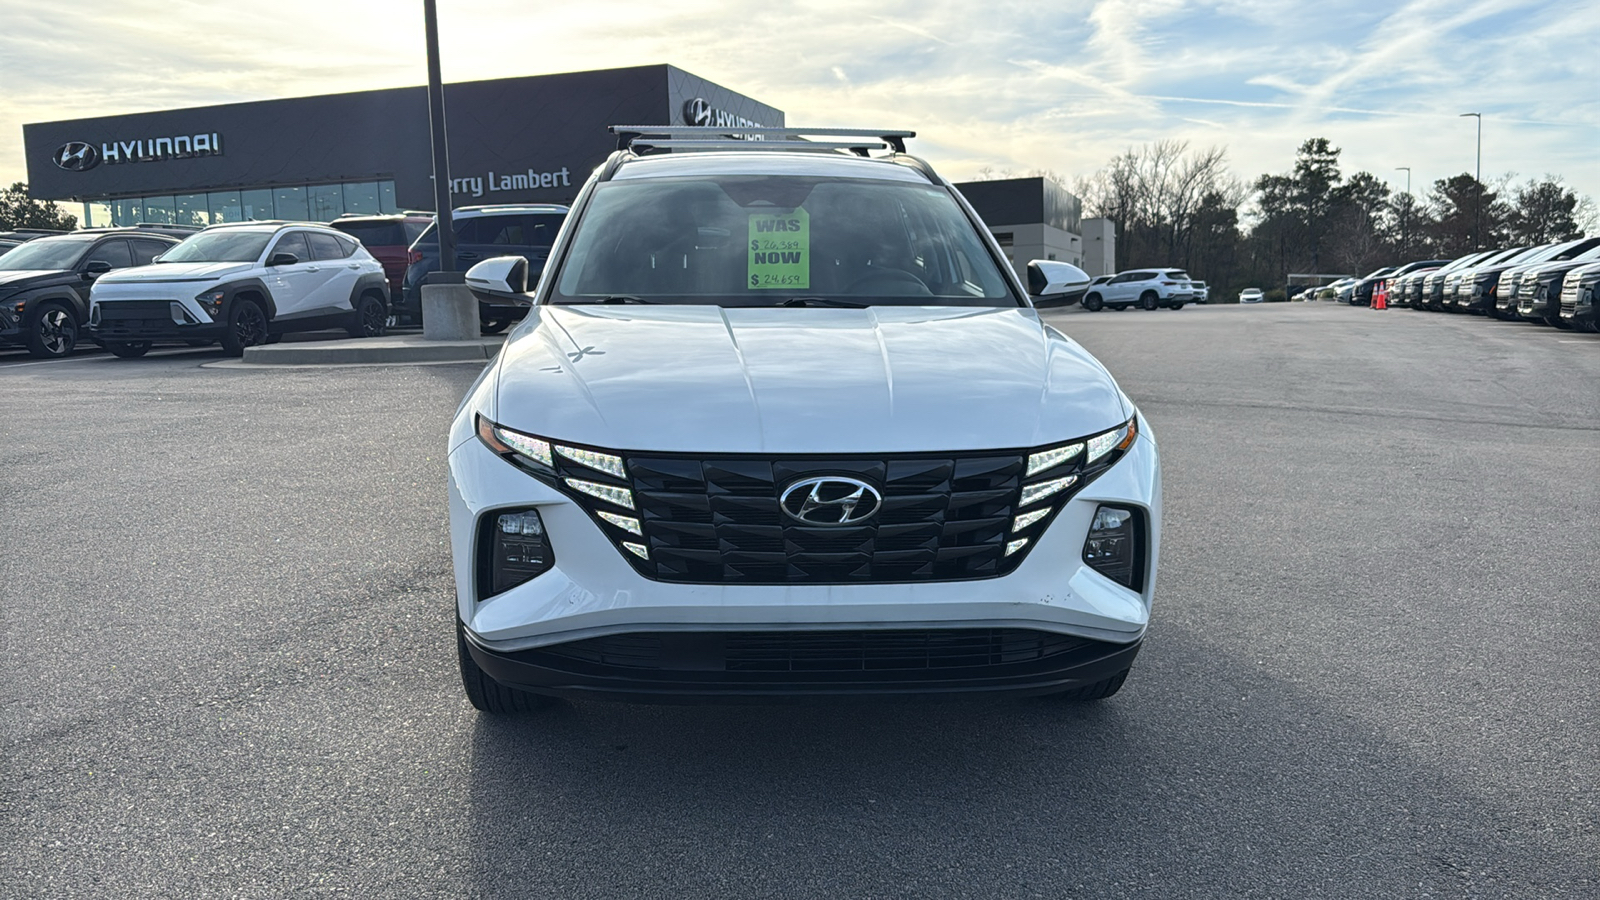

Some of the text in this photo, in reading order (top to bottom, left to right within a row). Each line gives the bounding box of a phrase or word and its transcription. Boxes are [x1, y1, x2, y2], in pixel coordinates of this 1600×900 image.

[102, 132, 219, 162] HYUNDAI
[488, 166, 571, 192] Lambert
[756, 220, 800, 232] WAS
[751, 239, 759, 251] $
[754, 252, 801, 264] NOW
[751, 273, 759, 286] $
